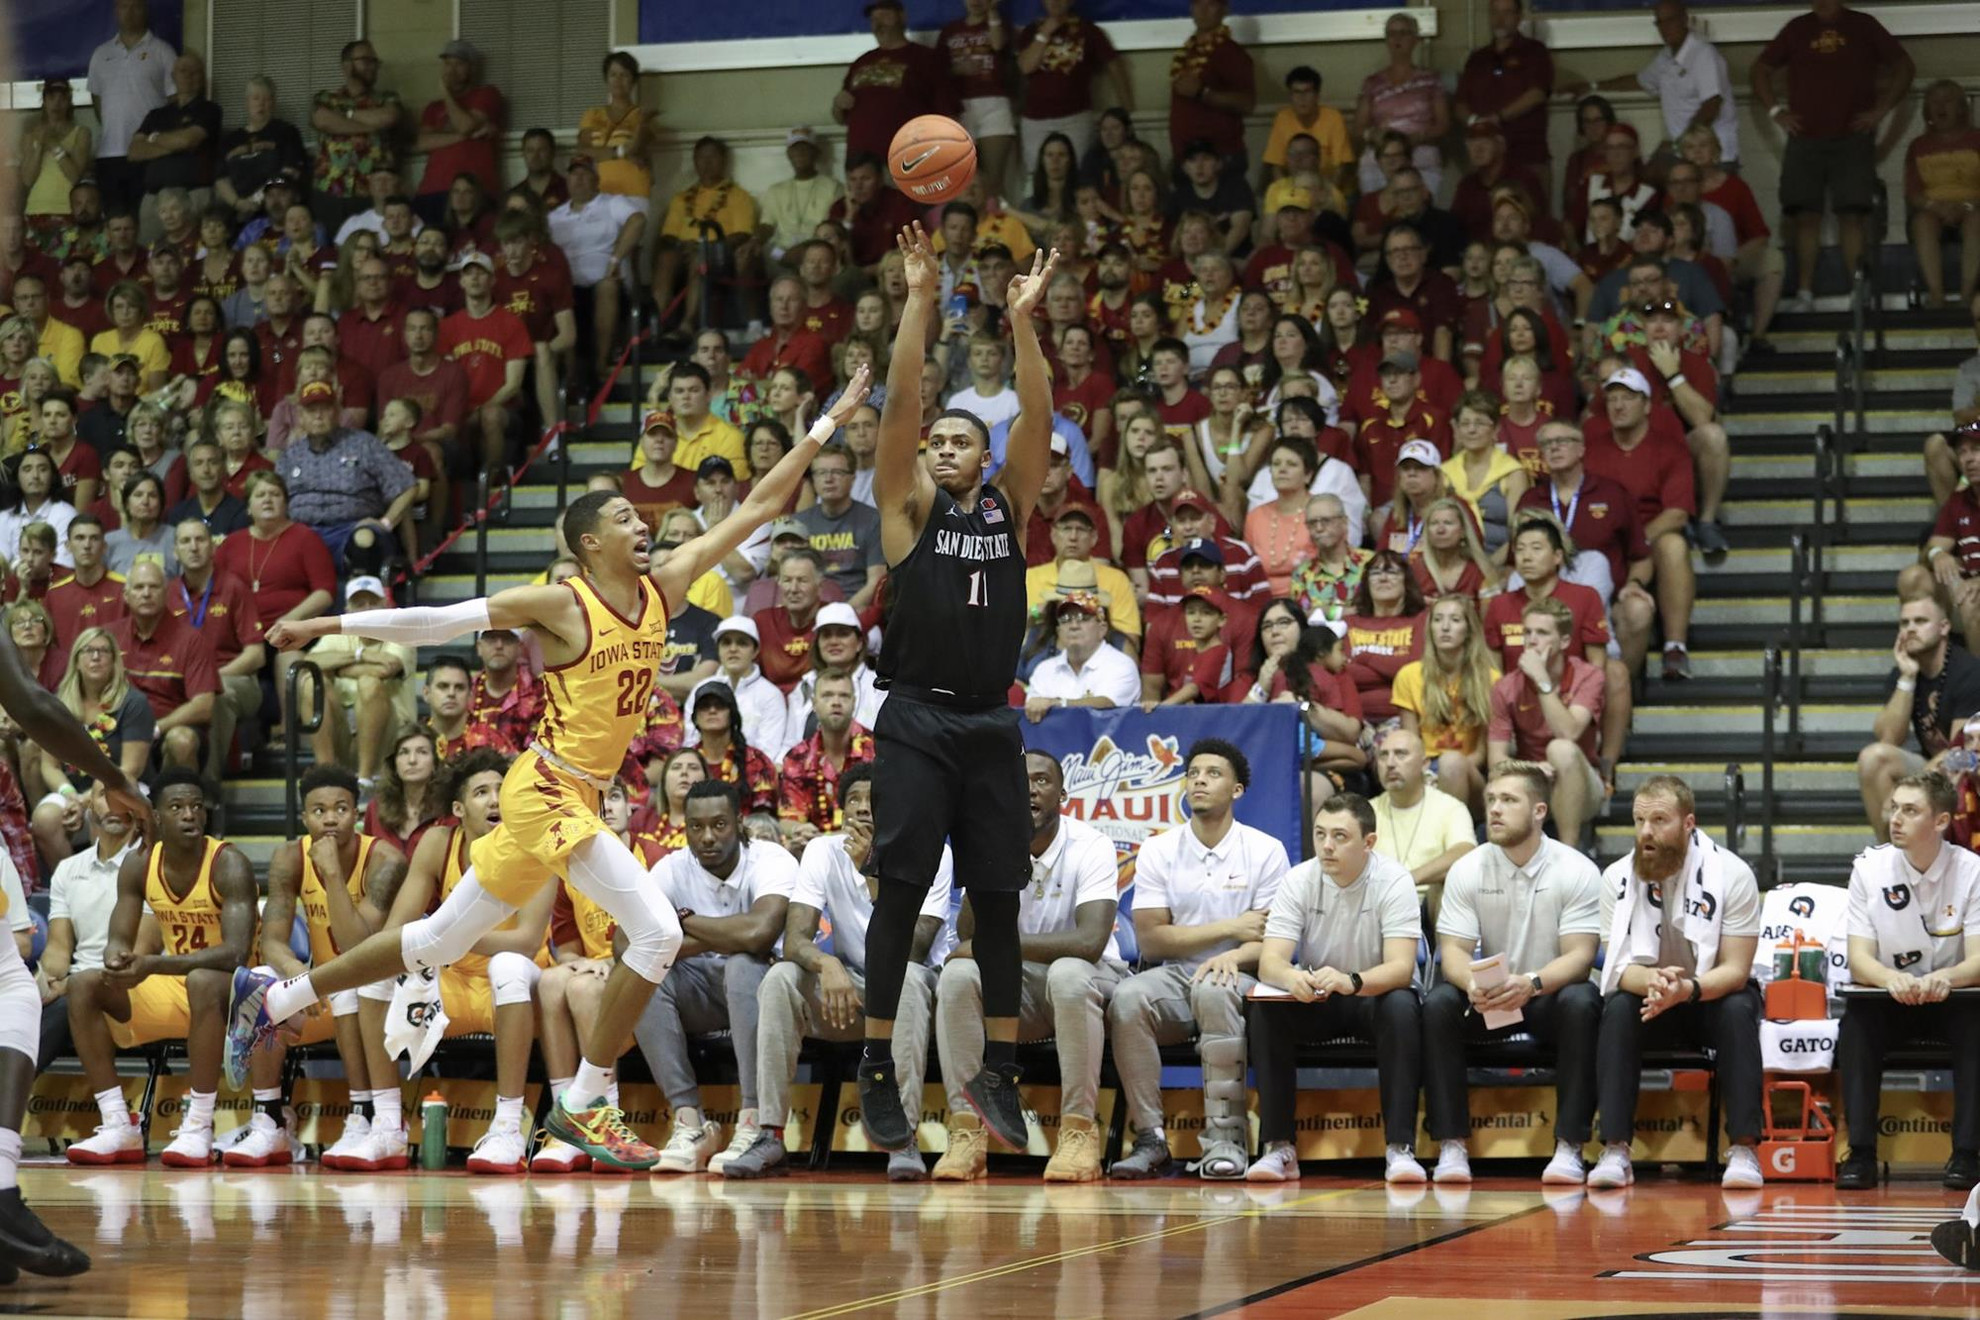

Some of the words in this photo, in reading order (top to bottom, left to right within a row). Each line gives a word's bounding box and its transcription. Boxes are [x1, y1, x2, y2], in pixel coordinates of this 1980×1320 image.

[808, 530, 855, 552] IOWA
[934, 529, 961, 556] SAN
[960, 534, 984, 562] DIE
[967, 570, 989, 607] 11
[590, 643, 629, 673] IOWA
[632, 641, 664, 660] STAT
[617, 668, 652, 717] 22
[1063, 756, 1098, 786] Maui
[1101, 750, 1146, 798] Jim
[1060, 793, 1170, 823] MAUI
[172, 924, 209, 955] 24
[1779, 1037, 1837, 1053] GATO
[28, 1095, 97, 1114] Continen
[295, 1102, 351, 1120] Contin
[1295, 1111, 1380, 1131] ntinental
[1470, 1110, 1532, 1129] nental
[1878, 1116, 1950, 1137] Contine
[1771, 1147, 1795, 1173] G
